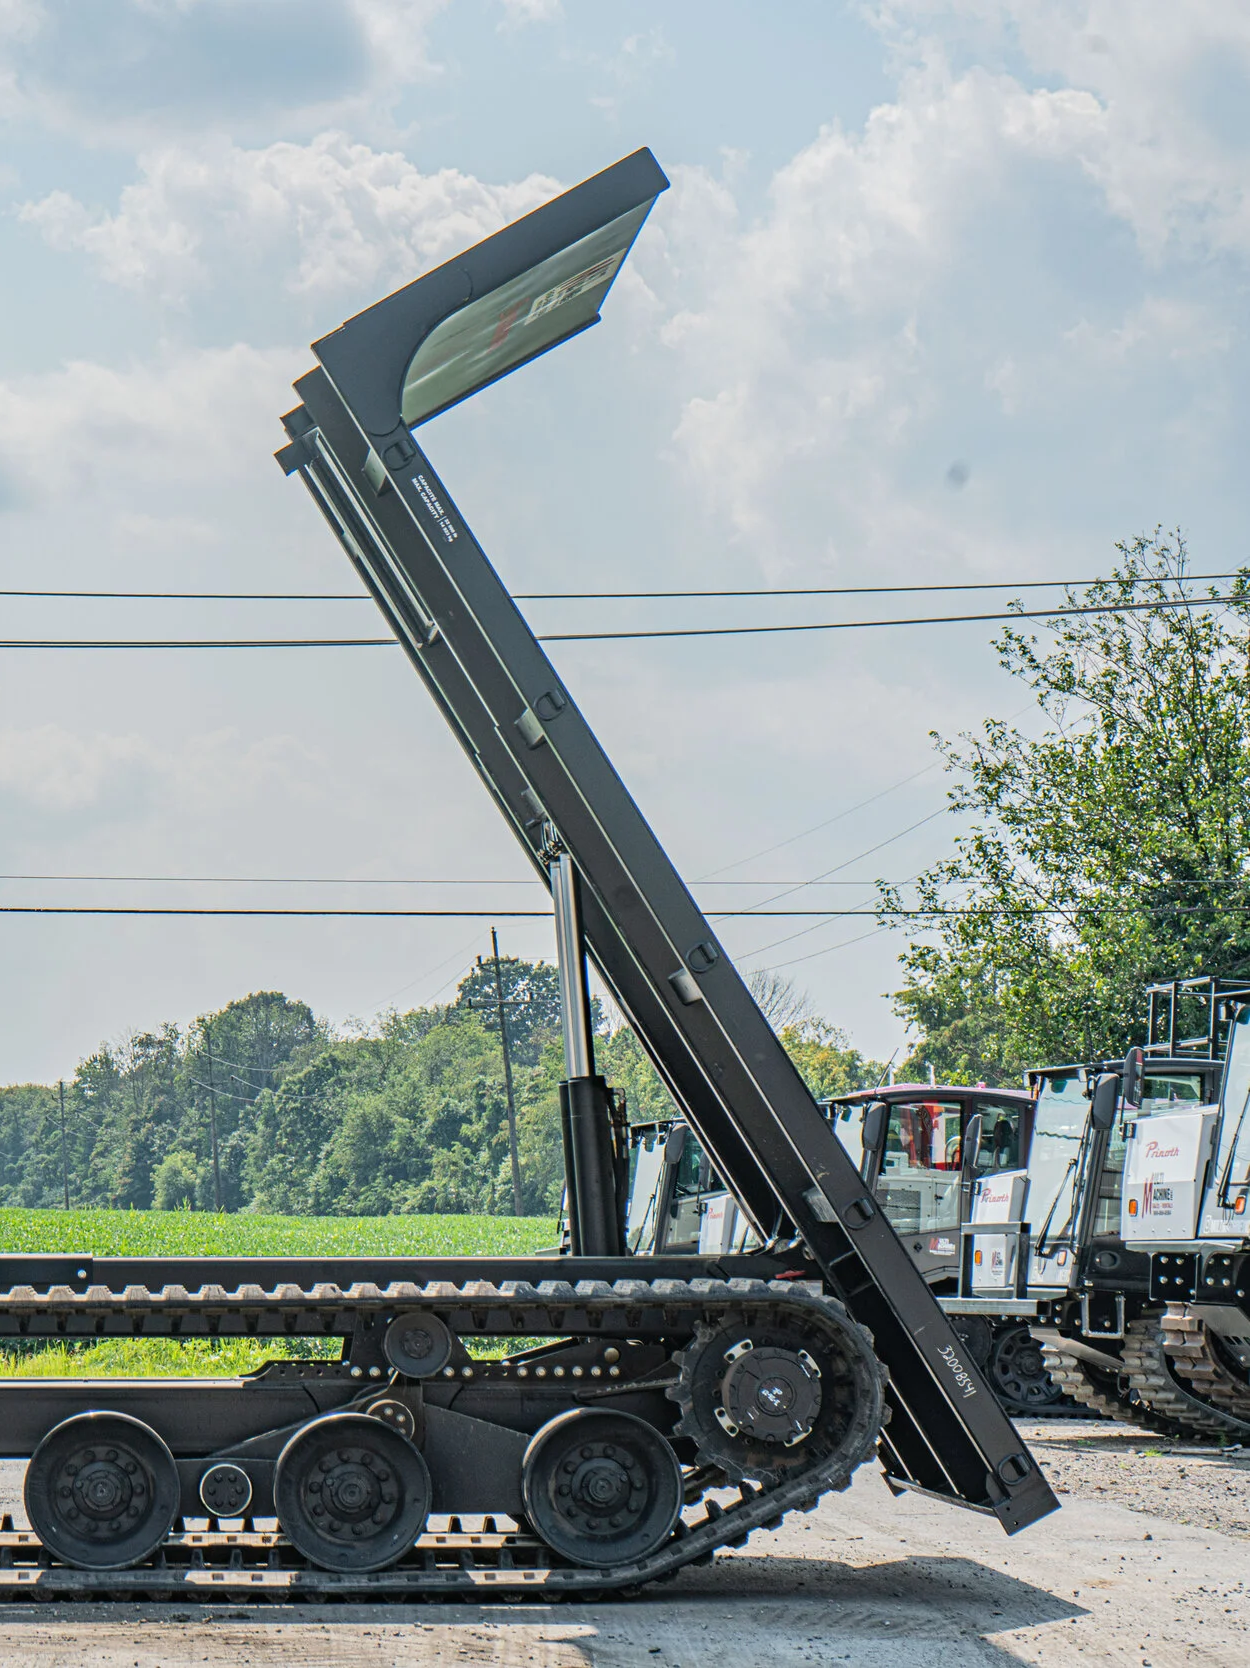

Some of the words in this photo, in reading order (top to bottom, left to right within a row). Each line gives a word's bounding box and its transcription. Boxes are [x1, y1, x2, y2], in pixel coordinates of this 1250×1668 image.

[420, 492, 439, 519] CAPACITY
[1145, 1141, 1179, 1158] Prinoth
[980, 1187, 1009, 1203] Prinoth
[936, 1344, 977, 1398] 32008541
